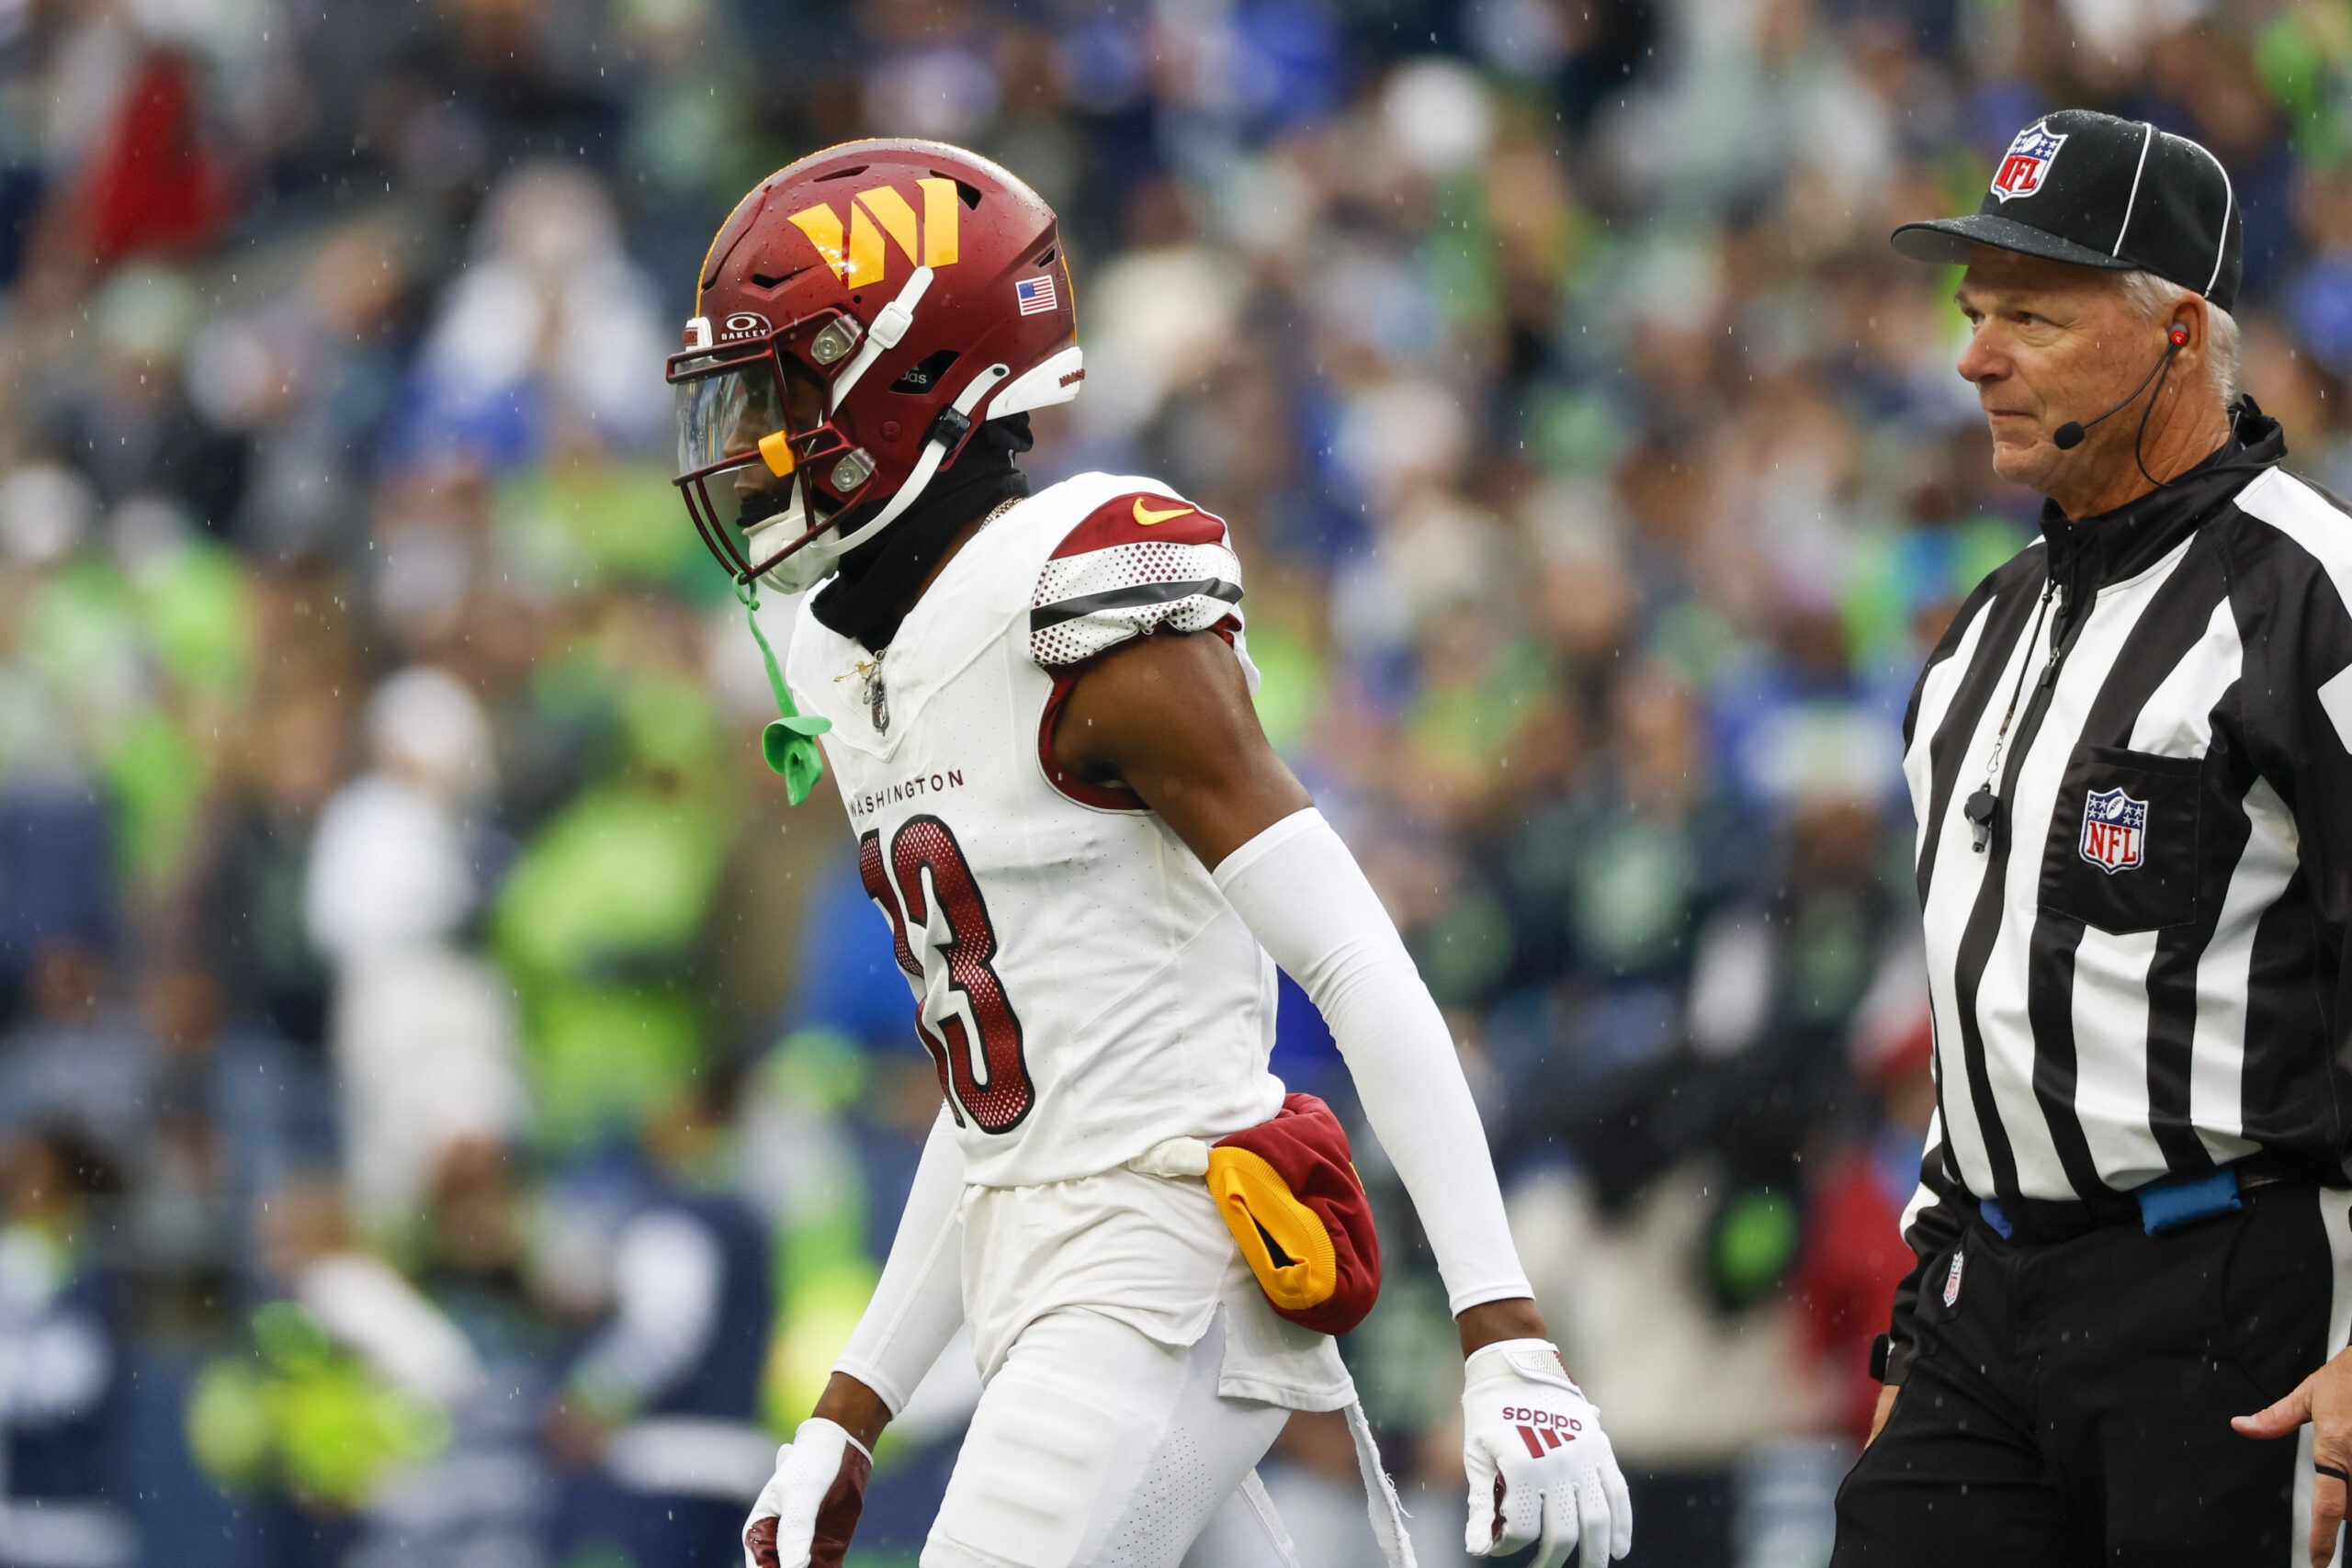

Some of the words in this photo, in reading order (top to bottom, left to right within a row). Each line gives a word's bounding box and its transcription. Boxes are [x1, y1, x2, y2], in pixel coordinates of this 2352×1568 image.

[1996, 155, 2041, 192] NFL
[721, 329, 766, 341] OAKLEY
[848, 770, 964, 818] WASHINGTON
[2086, 822, 2136, 864] NFL
[859, 814, 1035, 1135] 13
[1502, 1407, 1583, 1431] adidas
